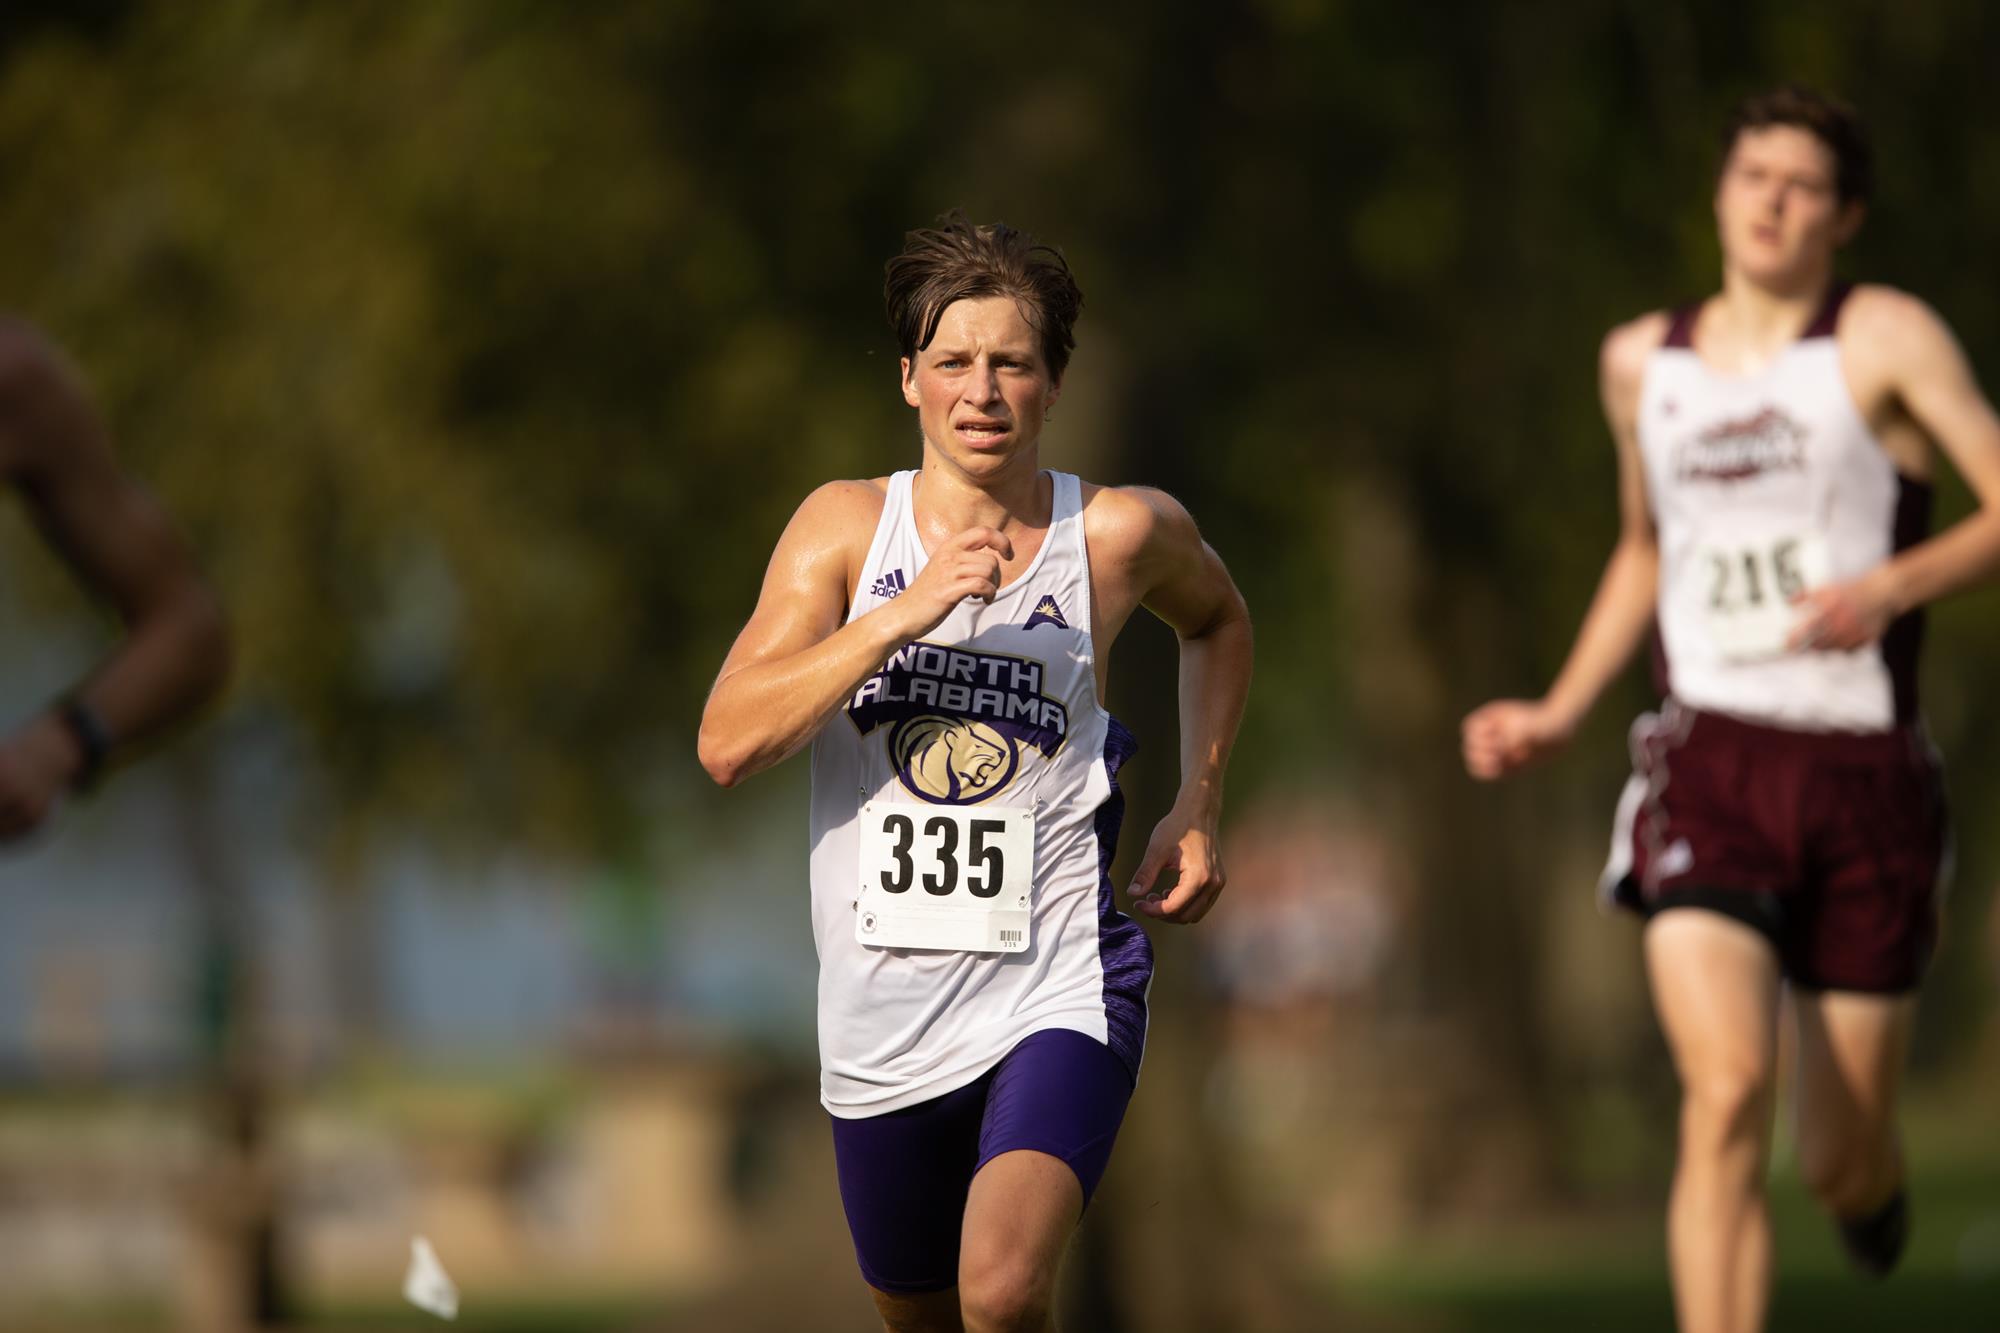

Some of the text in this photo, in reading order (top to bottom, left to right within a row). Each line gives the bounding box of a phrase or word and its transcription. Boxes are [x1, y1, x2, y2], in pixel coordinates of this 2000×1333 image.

[870, 584, 902, 600] adid
[887, 645, 1039, 693] NORTH
[853, 676, 1066, 732] ALABAMA
[881, 814, 1005, 898] 335
